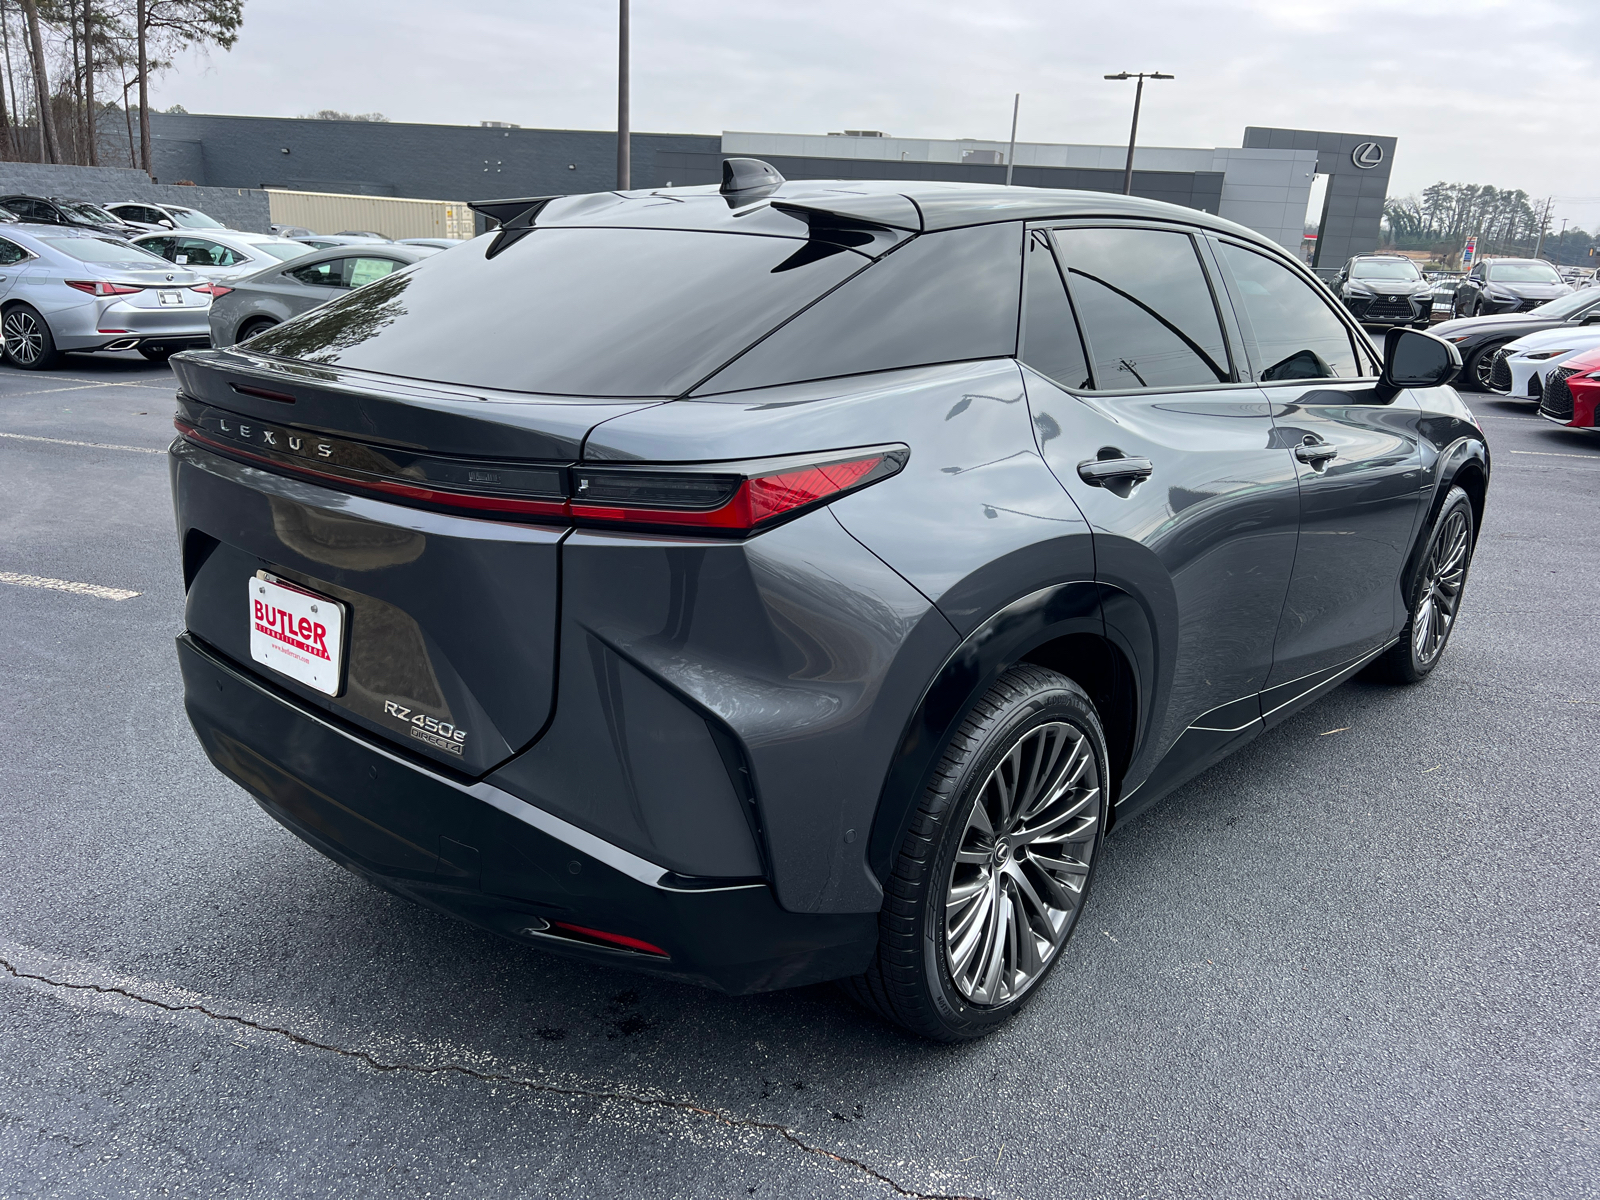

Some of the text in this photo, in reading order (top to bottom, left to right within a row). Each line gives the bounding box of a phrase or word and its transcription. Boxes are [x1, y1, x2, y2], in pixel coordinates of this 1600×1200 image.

[220, 419, 333, 457] LEXUS
[255, 622, 329, 660] AUTOMOTIVE GROUP
[271, 643, 310, 665] www.butlercars.com
